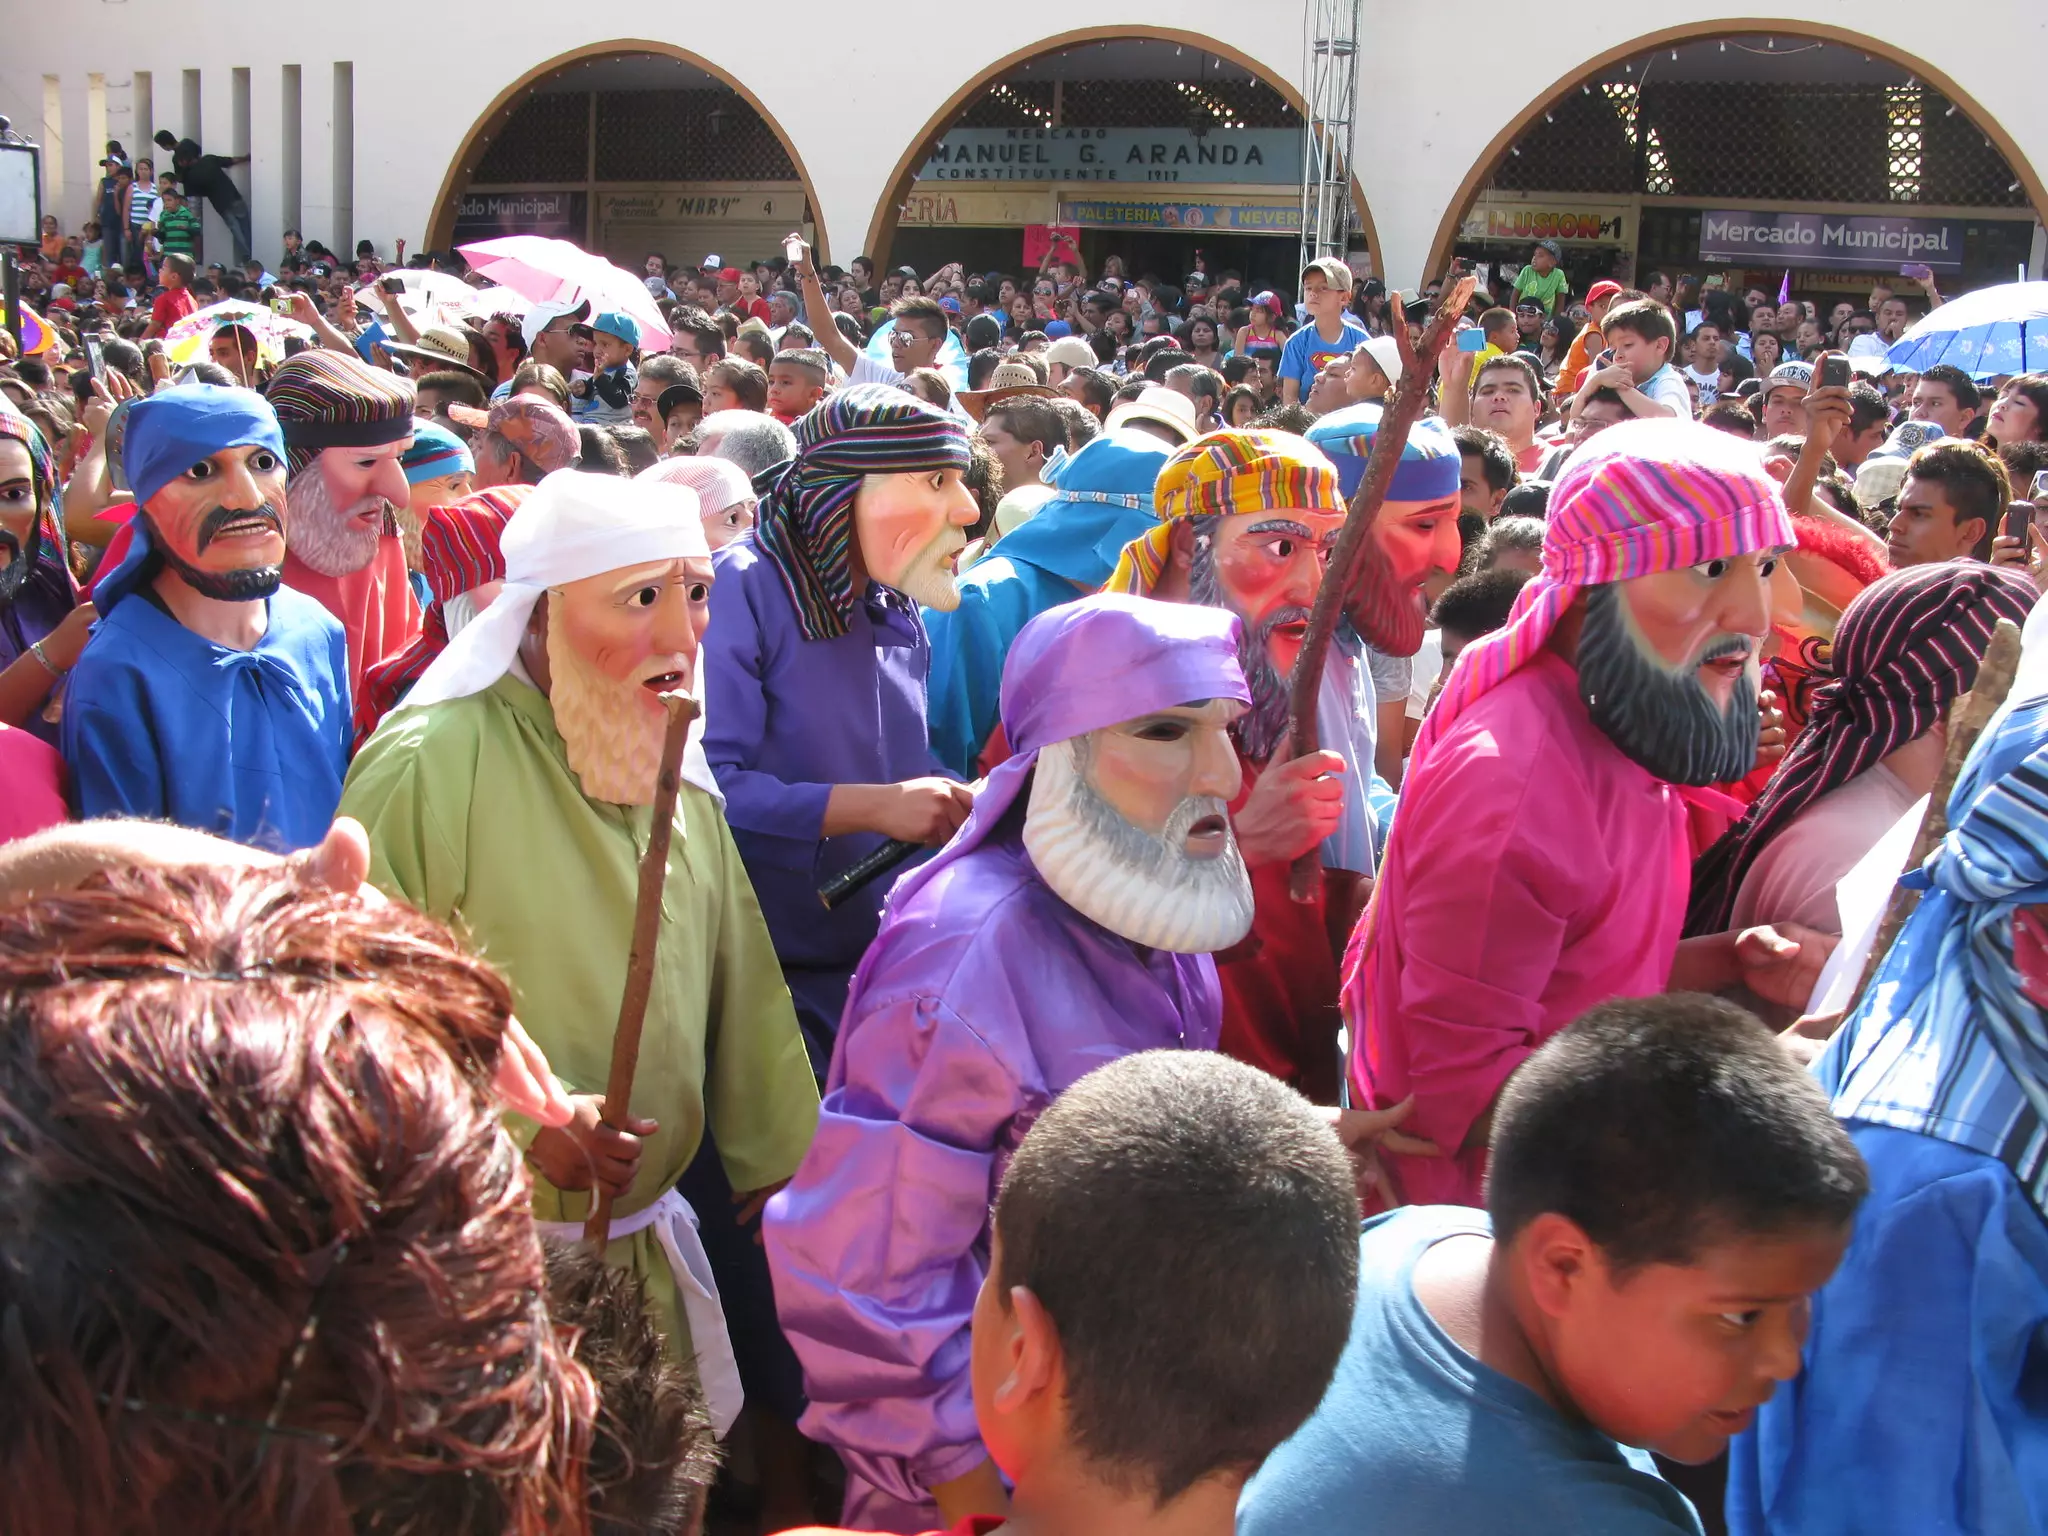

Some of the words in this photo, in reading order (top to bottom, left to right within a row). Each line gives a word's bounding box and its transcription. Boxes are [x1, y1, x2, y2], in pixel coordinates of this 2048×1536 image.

[1007, 128, 1107, 139] MERCADO
[930, 144, 1050, 164] MANUEL
[1079, 144, 1104, 164] G.
[1126, 144, 1263, 165] ARANDA
[1147, 170, 1179, 181] 1917
[488, 196, 560, 219] Municipal
[763, 200, 773, 215] 4
[1077, 206, 1161, 222] PALETERIA
[1487, 211, 1601, 239] ILUSION
[1706, 219, 1816, 245] Mercado
[1822, 223, 1949, 256] Municipal
